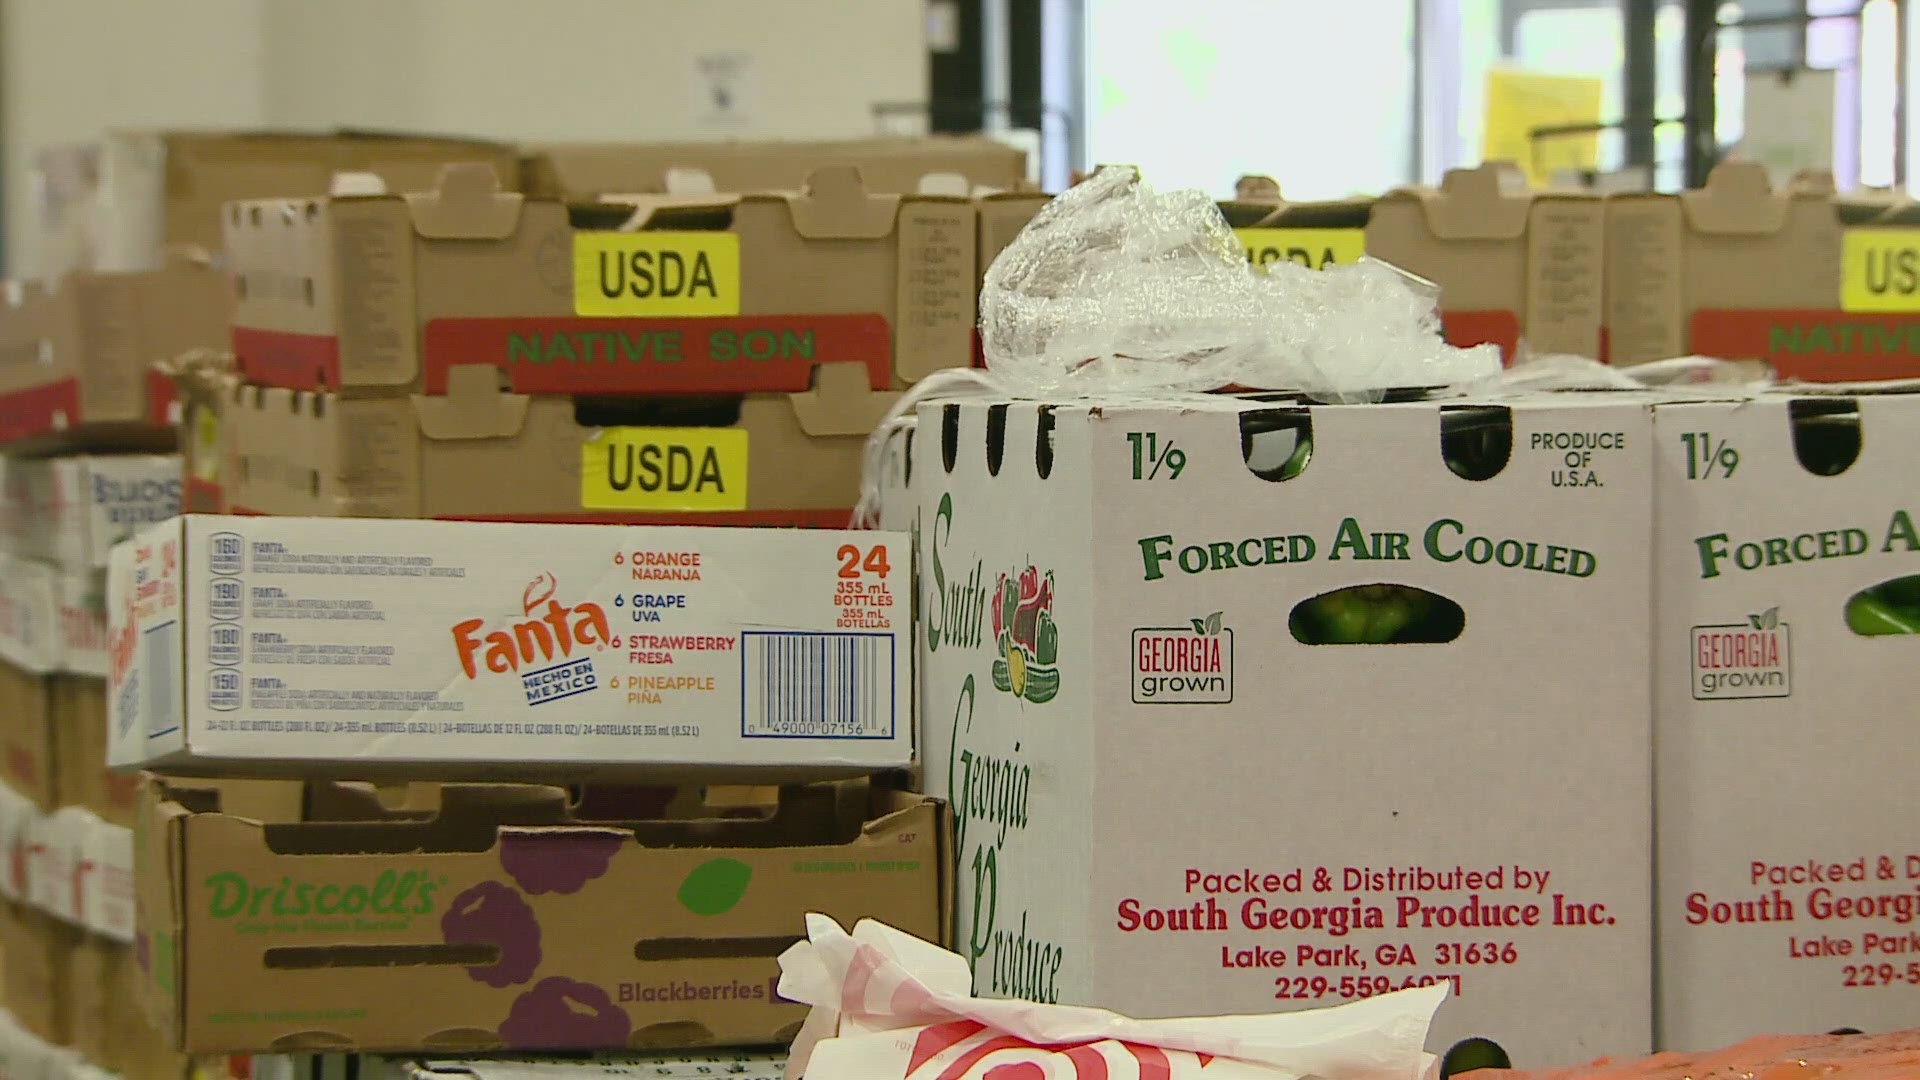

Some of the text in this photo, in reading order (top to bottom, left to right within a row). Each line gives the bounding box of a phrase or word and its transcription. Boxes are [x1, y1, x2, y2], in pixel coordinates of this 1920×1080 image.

[600, 250, 718, 298] USDA
[506, 328, 816, 365] NATIVE SON
[1531, 432, 1625, 450] PRODUCE
[608, 443, 725, 494] USDA
[1565, 451, 1591, 468] OF
[1551, 470, 1604, 487] U.S.A.
[614, 551, 701, 566] 6 ORANGE
[836, 544, 891, 579] 24
[1138, 533, 1316, 581] FORCED
[1423, 518, 1597, 579] COOLED
[1694, 528, 1869, 579] FORCED
[632, 568, 702, 581] NARANJA
[928, 492, 986, 653] South
[833, 594, 894, 606] BOTTLES
[836, 581, 890, 594] 355 mL
[614, 593, 686, 608] 6 GRAPE
[632, 611, 661, 622] UVA
[836, 618, 891, 628] BOTELLAS
[842, 608, 885, 619] 355 mL
[452, 600, 611, 680] Fanta
[611, 635, 736, 650] 6 STRAWBERRY
[1697, 633, 1780, 669] GEORGIA
[629, 652, 673, 664] FRESA
[1139, 637, 1221, 673] GEORGIA
[523, 663, 594, 689] HECHO EN
[526, 674, 597, 701] MEXICO
[610, 676, 715, 690] 6 PINEAPPLE
[1141, 677, 1225, 697] grown
[1701, 670, 1783, 693] grown
[628, 689, 662, 704] PIÑA
[773, 722, 816, 734] 49000
[821, 722, 864, 735] 07156
[949, 673, 1031, 865] Georgia
[1185, 865, 1551, 895] Packed & Distributed by
[1751, 856, 1866, 886] Packed
[1876, 855, 1895, 881] &
[205, 869, 437, 918] Driscoll's
[1685, 887, 1794, 925] South
[970, 843, 1063, 1004] Produce
[1117, 893, 1616, 937] South Georgia Produce Inc.
[1222, 941, 1518, 971] Lake Park, GA 31636
[1788, 934, 1853, 959] Lake
[619, 980, 765, 1003] Blackberries
